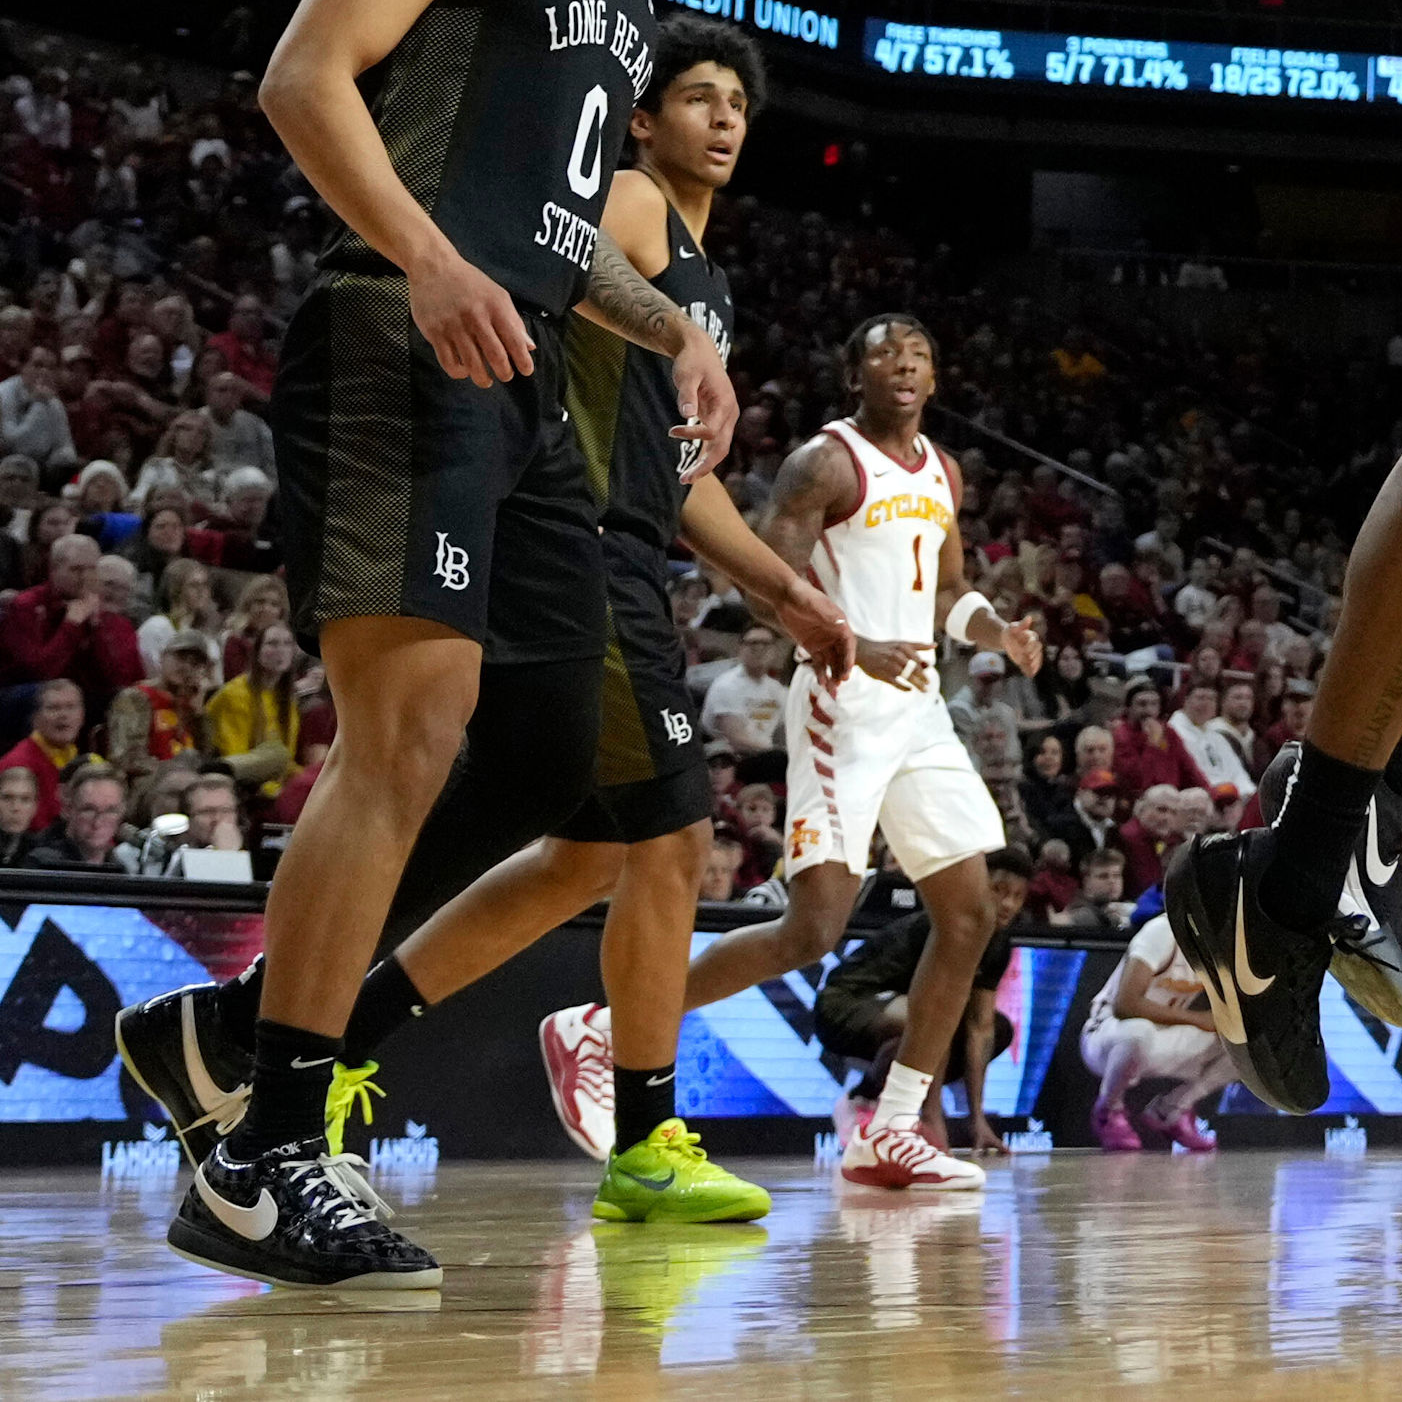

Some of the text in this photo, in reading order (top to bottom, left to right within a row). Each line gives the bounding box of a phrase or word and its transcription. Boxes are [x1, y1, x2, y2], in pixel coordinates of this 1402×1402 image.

[545, 0, 607, 51] LONG
[923, 44, 1014, 79] 57.1%
[1046, 52, 1188, 90] 5/7 71.4%
[1210, 62, 1359, 101] 18/25 72.0%
[567, 83, 608, 200] 0
[534, 201, 598, 272] STATE
[433, 531, 470, 590] LB
[912, 533, 923, 592] 1
[660, 708, 692, 746] LB
